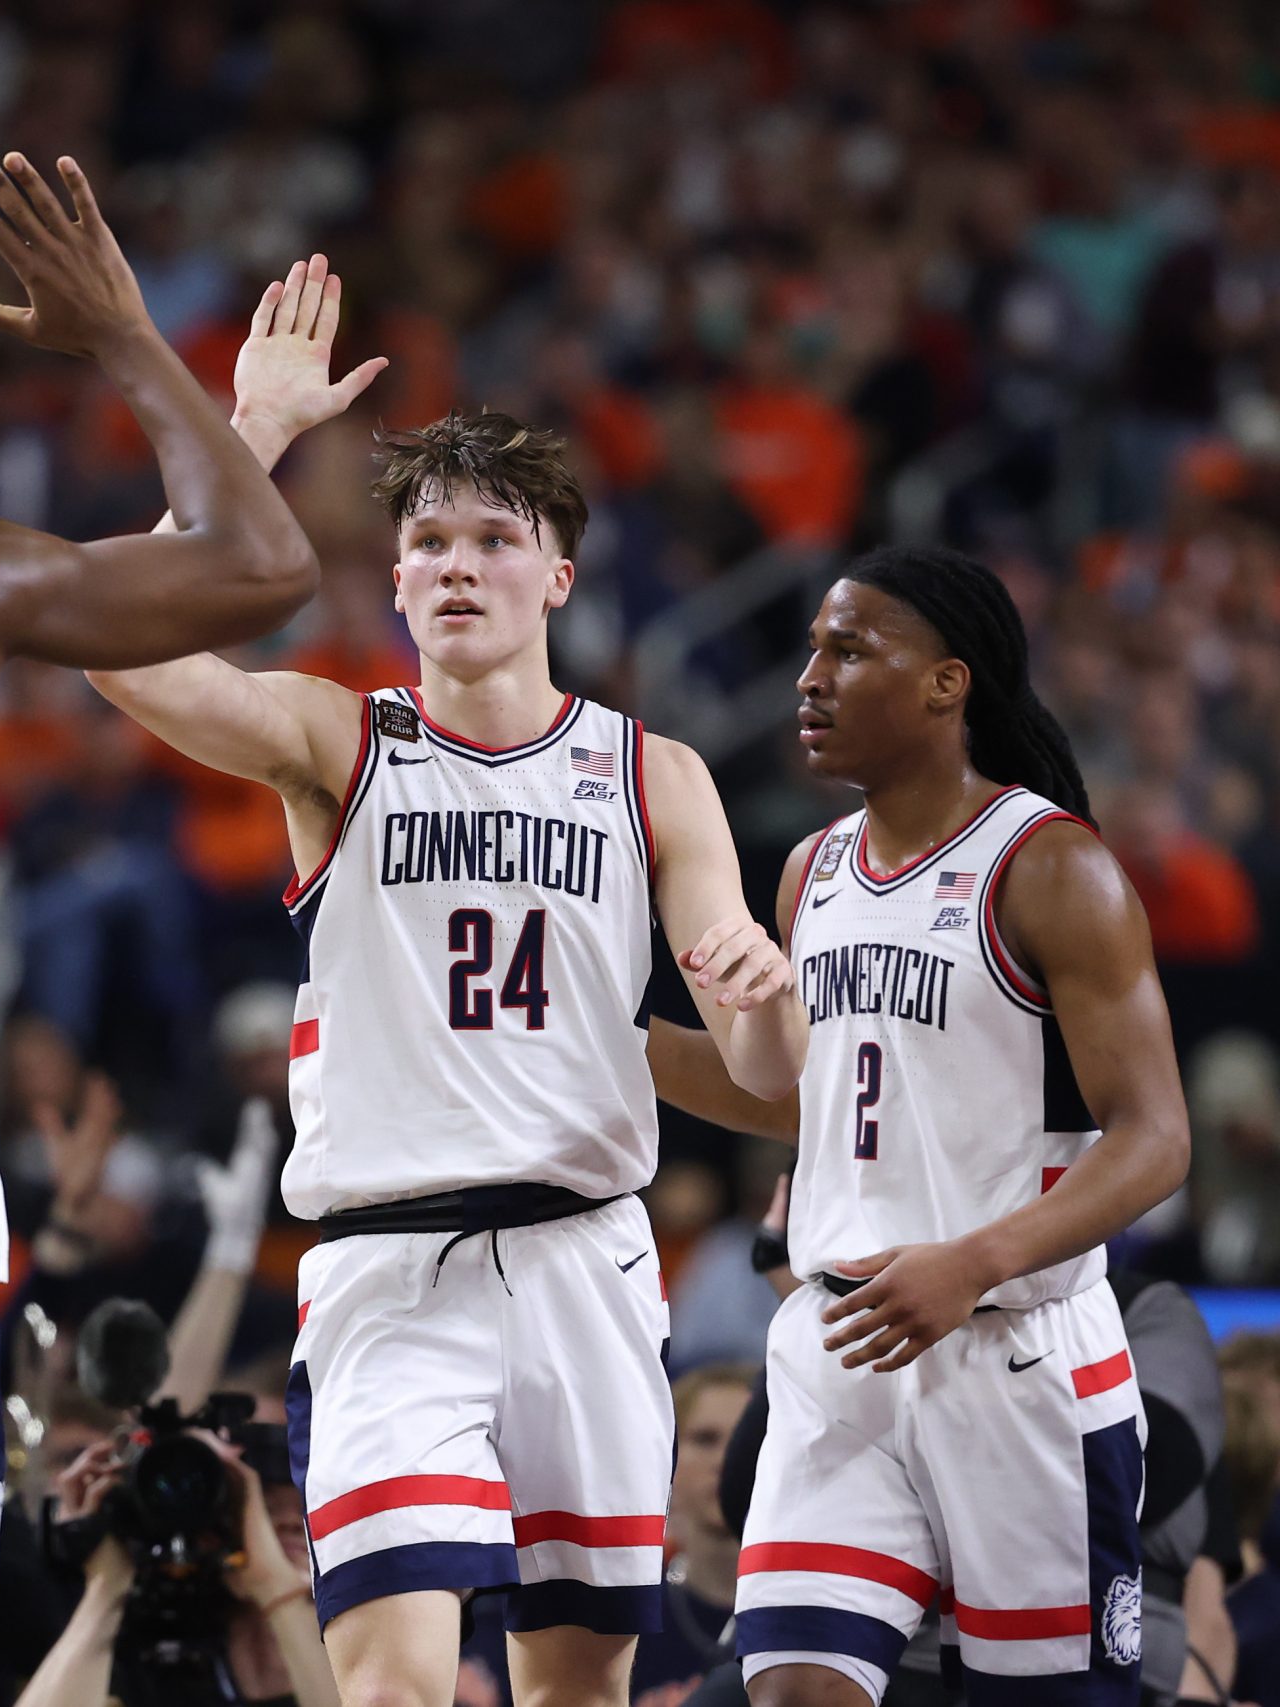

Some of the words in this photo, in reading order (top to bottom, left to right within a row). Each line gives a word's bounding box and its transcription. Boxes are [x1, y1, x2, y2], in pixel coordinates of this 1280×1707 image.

[383, 706, 413, 720] FINAL
[384, 722, 413, 735] FOUR
[578, 780, 609, 791] BIG
[574, 788, 618, 800] EAST
[381, 810, 608, 904] CONNECTICUT
[939, 907, 966, 918] BIG
[933, 917, 971, 927] EAST
[448, 908, 549, 1030] 24
[803, 943, 955, 1031] CONNECTICUT
[854, 1041, 882, 1160] 2
